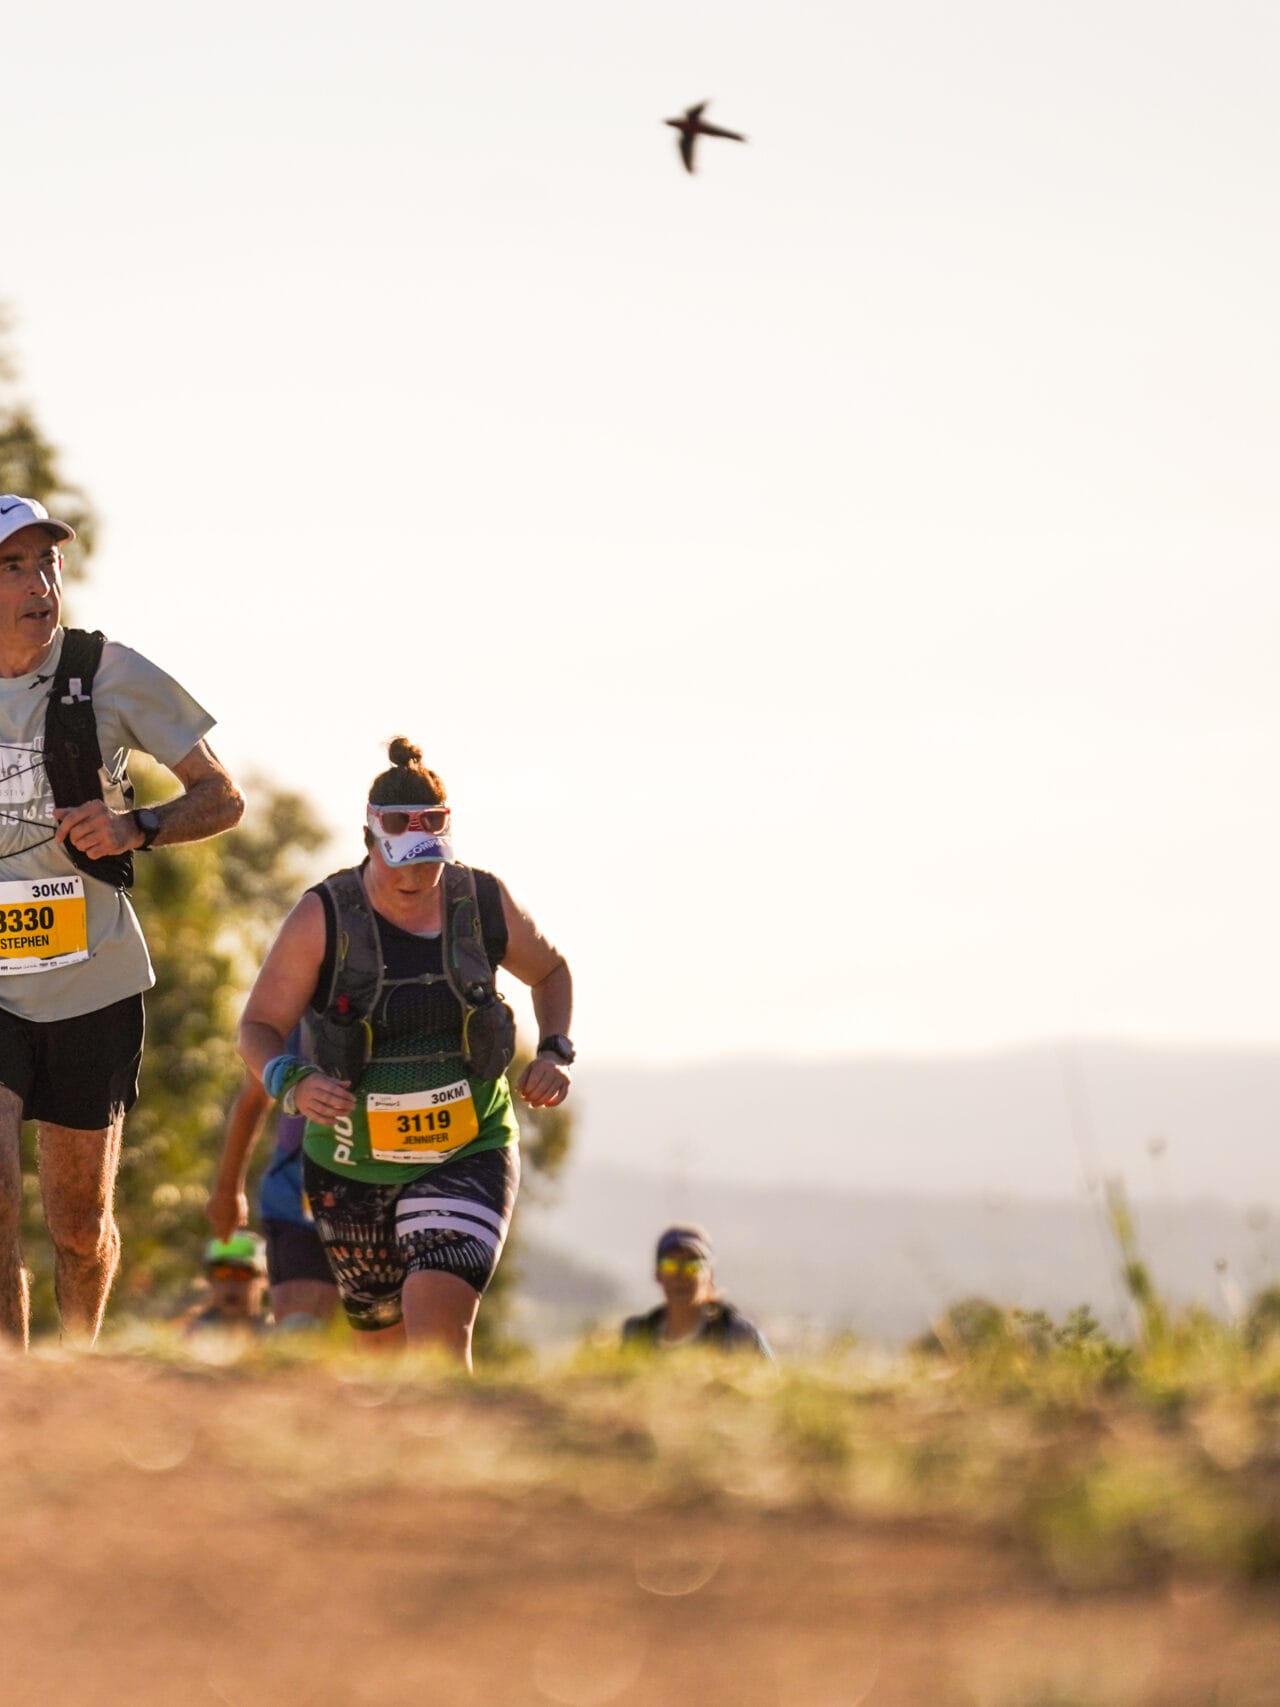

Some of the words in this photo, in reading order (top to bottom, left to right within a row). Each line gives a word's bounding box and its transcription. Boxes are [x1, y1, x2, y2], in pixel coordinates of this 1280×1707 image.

[32, 882, 74, 898] 30KM
[0, 935, 49, 950] STEPHEN
[431, 1086, 465, 1104] 30KM
[397, 1110, 451, 1133] 3119
[402, 1133, 449, 1145] JENNIFER
